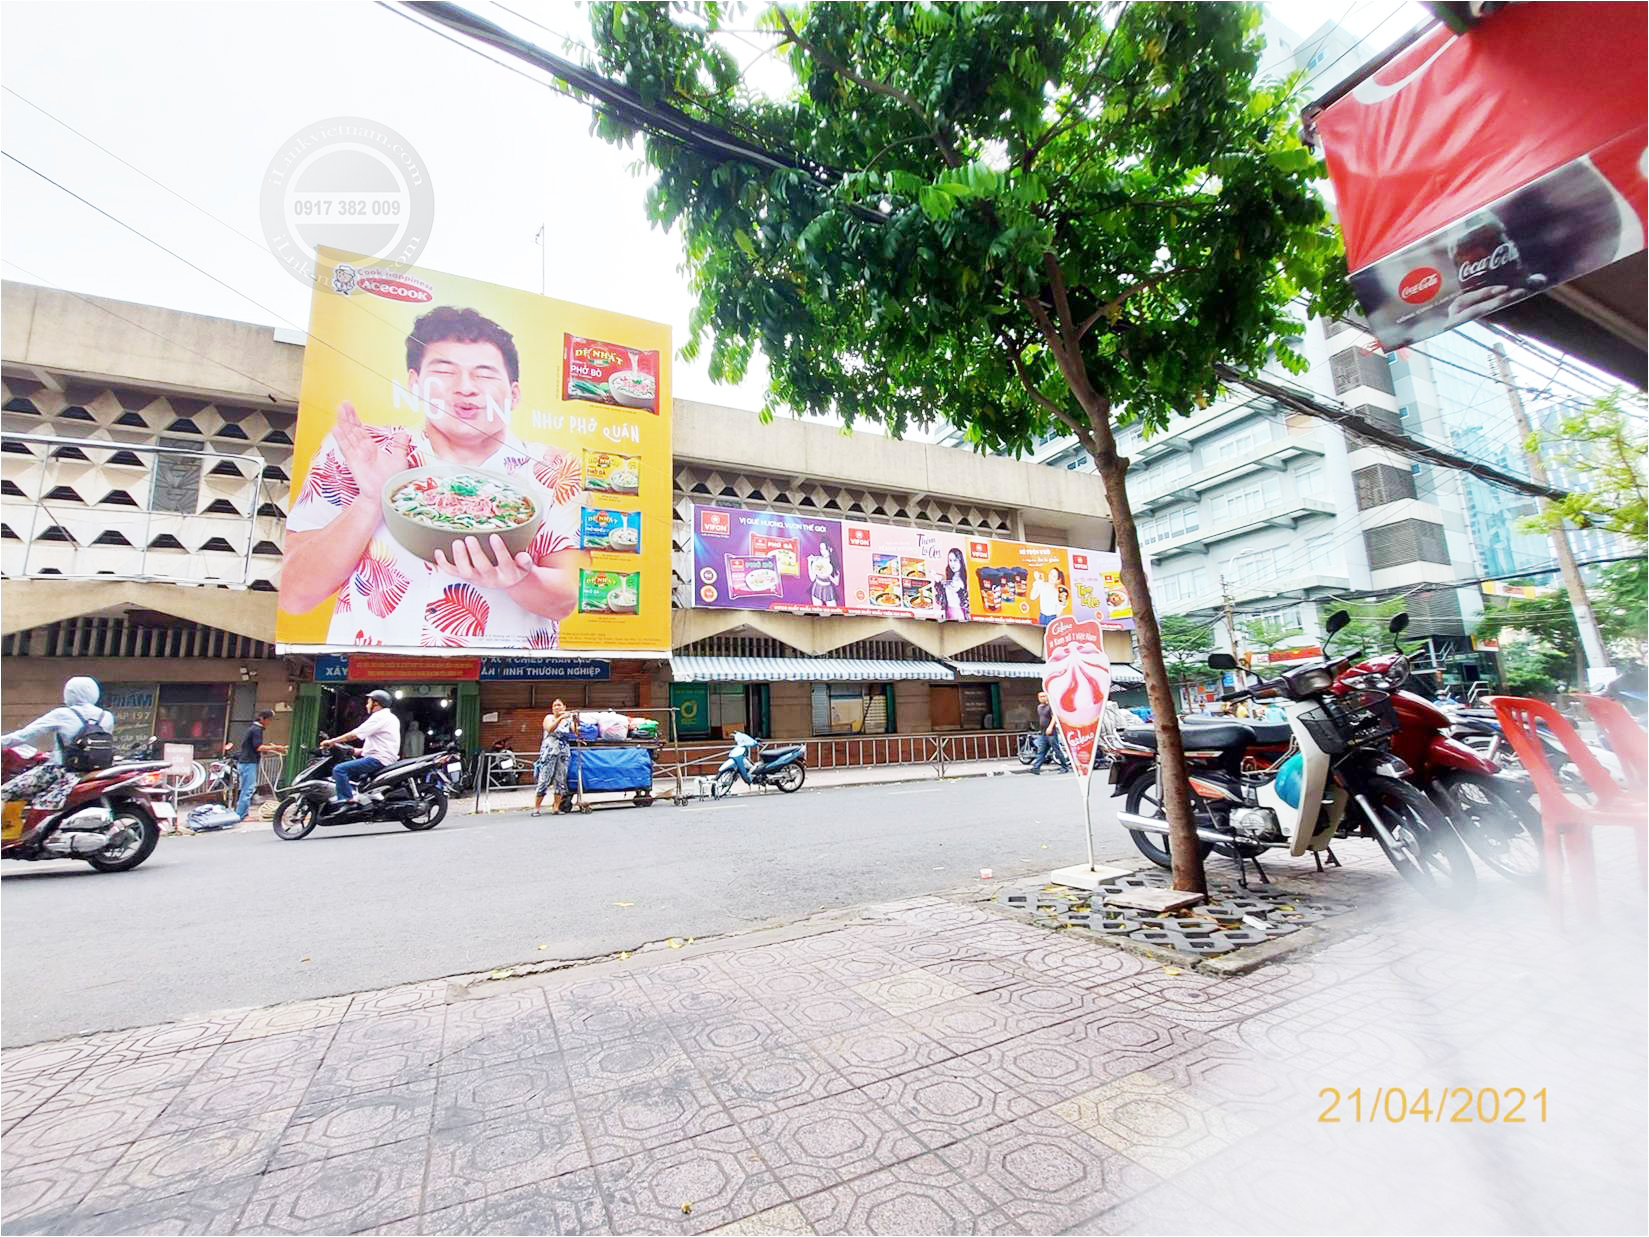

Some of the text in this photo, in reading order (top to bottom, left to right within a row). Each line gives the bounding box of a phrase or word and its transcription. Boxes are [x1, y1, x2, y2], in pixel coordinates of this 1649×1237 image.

[1458, 243, 1518, 282] Coca-Cola
[1401, 273, 1438, 299] Coca-Cola
[532, 411, 640, 443] NHƯ PHỞ QUÁN
[704, 523, 727, 532] VIFON
[567, 666, 601, 678] NGHIỆP
